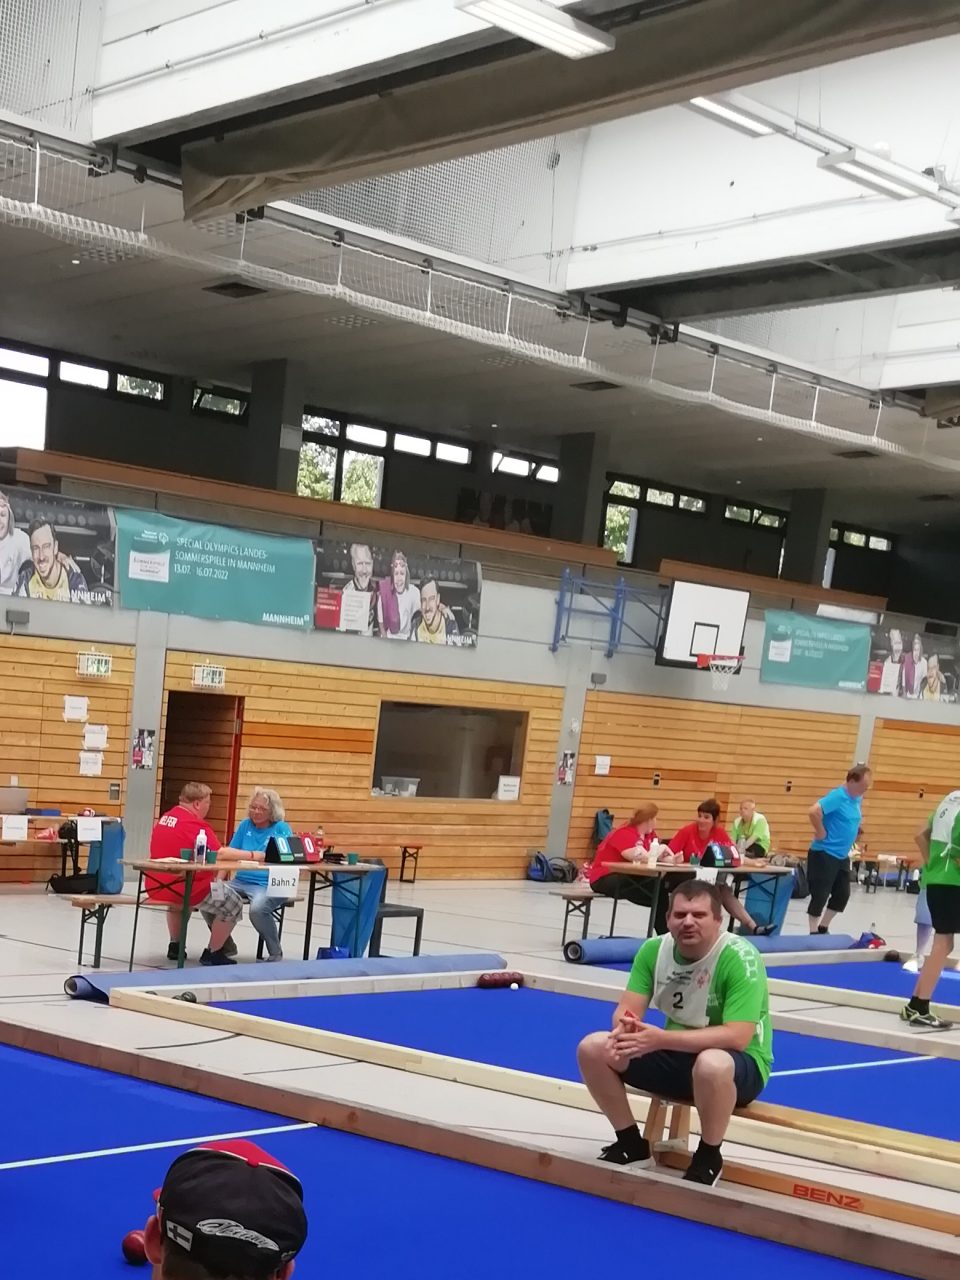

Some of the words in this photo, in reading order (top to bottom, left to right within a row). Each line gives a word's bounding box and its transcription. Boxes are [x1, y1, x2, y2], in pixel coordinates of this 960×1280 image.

[176, 537, 203, 549] SPECIAL
[204, 541, 238, 555] OLYMPICS
[175, 550, 226, 567] SOMMERSPIELE
[227, 558, 236, 568] IN
[237, 560, 275, 574] MANNHEIM
[278, 837, 288, 853] 0
[304, 837, 315, 853] 0
[271, 877, 290, 887] Bahn
[291, 878, 297, 887] 2
[672, 991, 684, 1009] 2
[793, 1184, 862, 1209] BENZ
